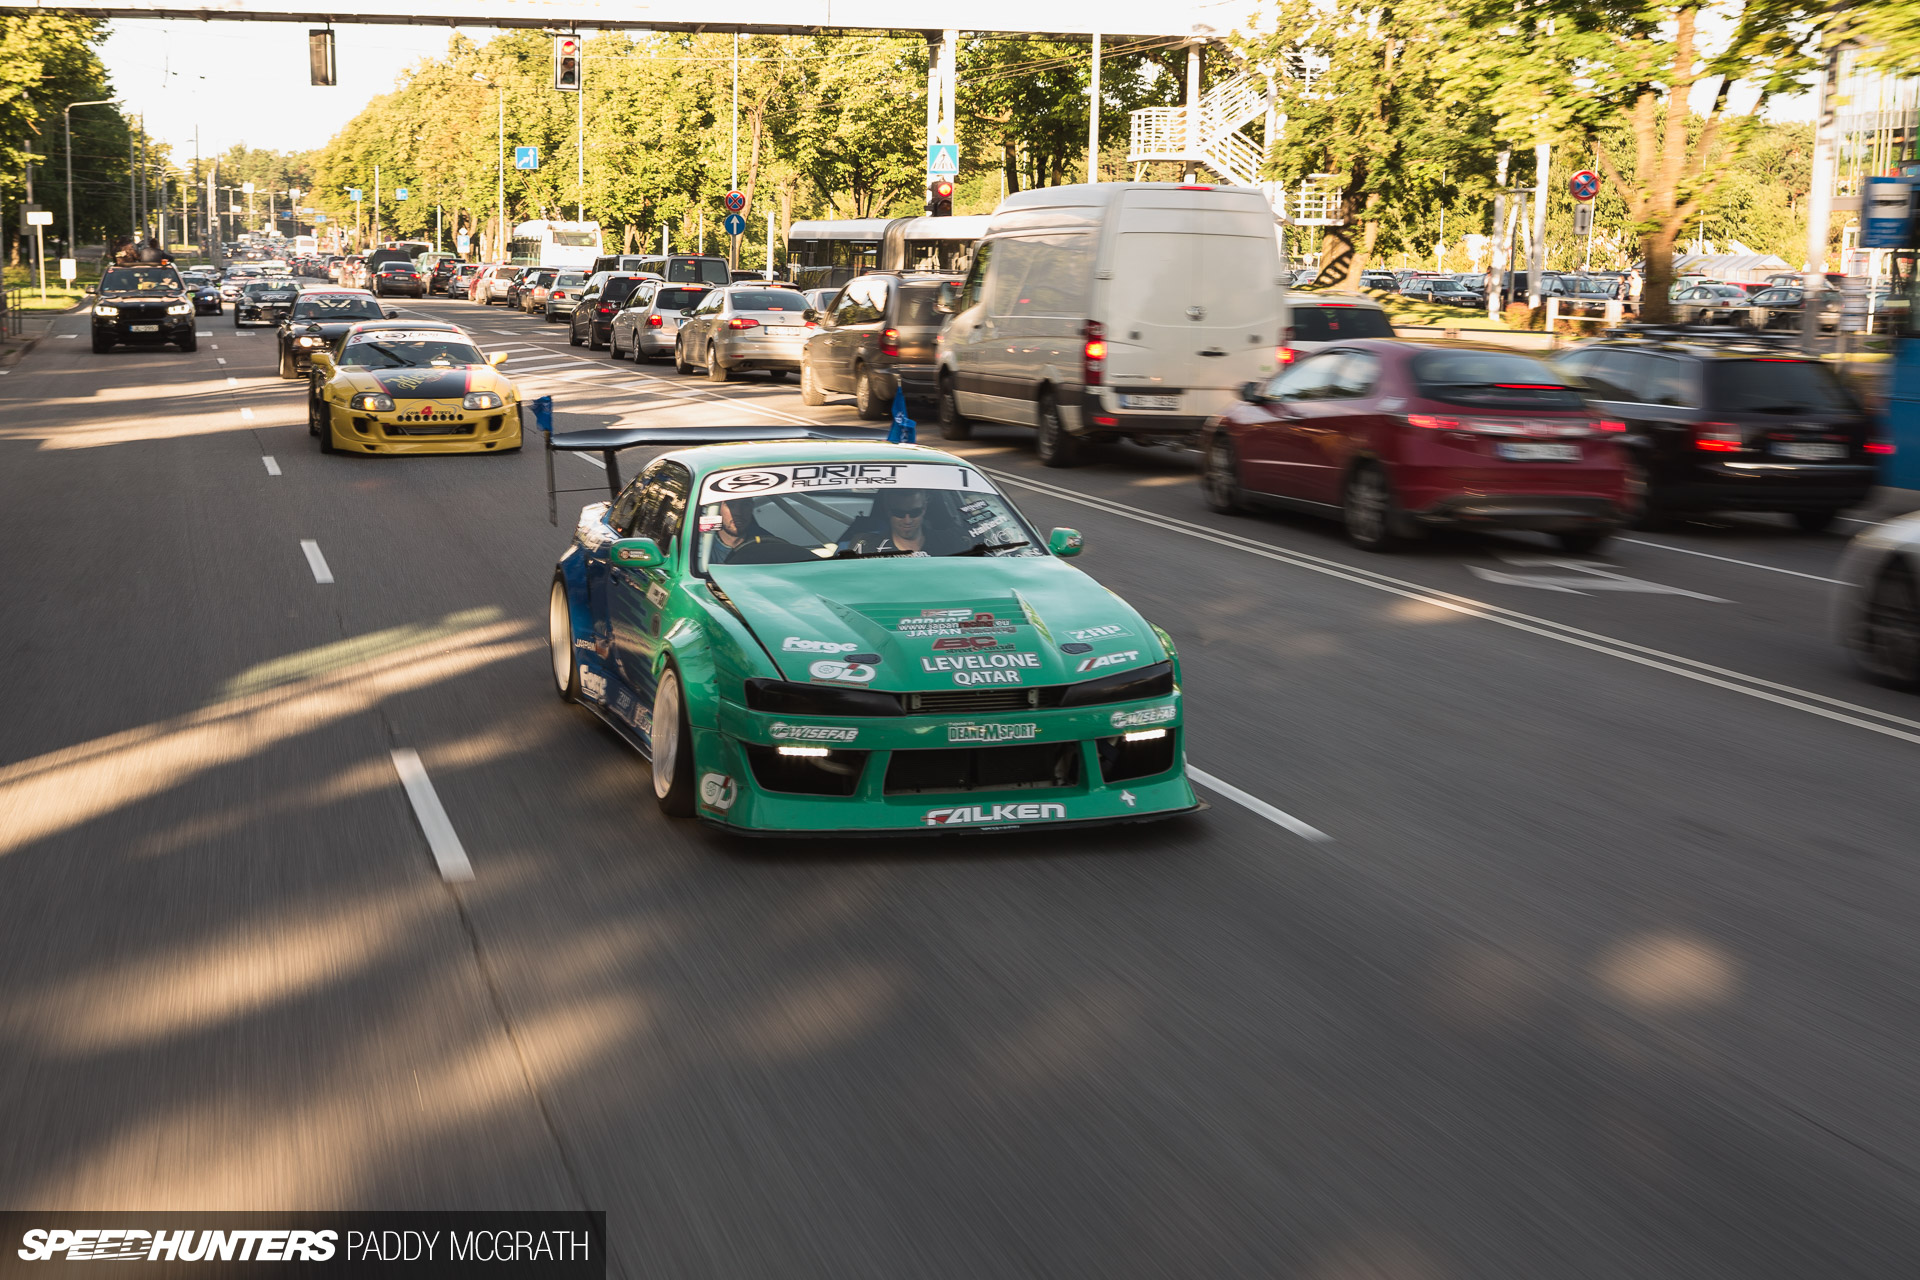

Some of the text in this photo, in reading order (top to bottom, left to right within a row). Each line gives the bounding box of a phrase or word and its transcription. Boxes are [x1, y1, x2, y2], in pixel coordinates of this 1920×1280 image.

[421, 405, 434, 417] 4
[792, 464, 908, 480] DRIFT
[958, 468, 969, 488] 1
[791, 476, 898, 488] ALLSTARS
[968, 515, 1009, 538] Haltech
[906, 628, 962, 637] JAPAN
[782, 636, 858, 654] Forge
[932, 636, 998, 651] BC
[921, 653, 1041, 672] LEVELONE
[953, 670, 1021, 685] QATAR
[1125, 706, 1177, 726] WISEFAB
[789, 726, 859, 742] WISEFAB
[924, 803, 1066, 826] FALKEN
